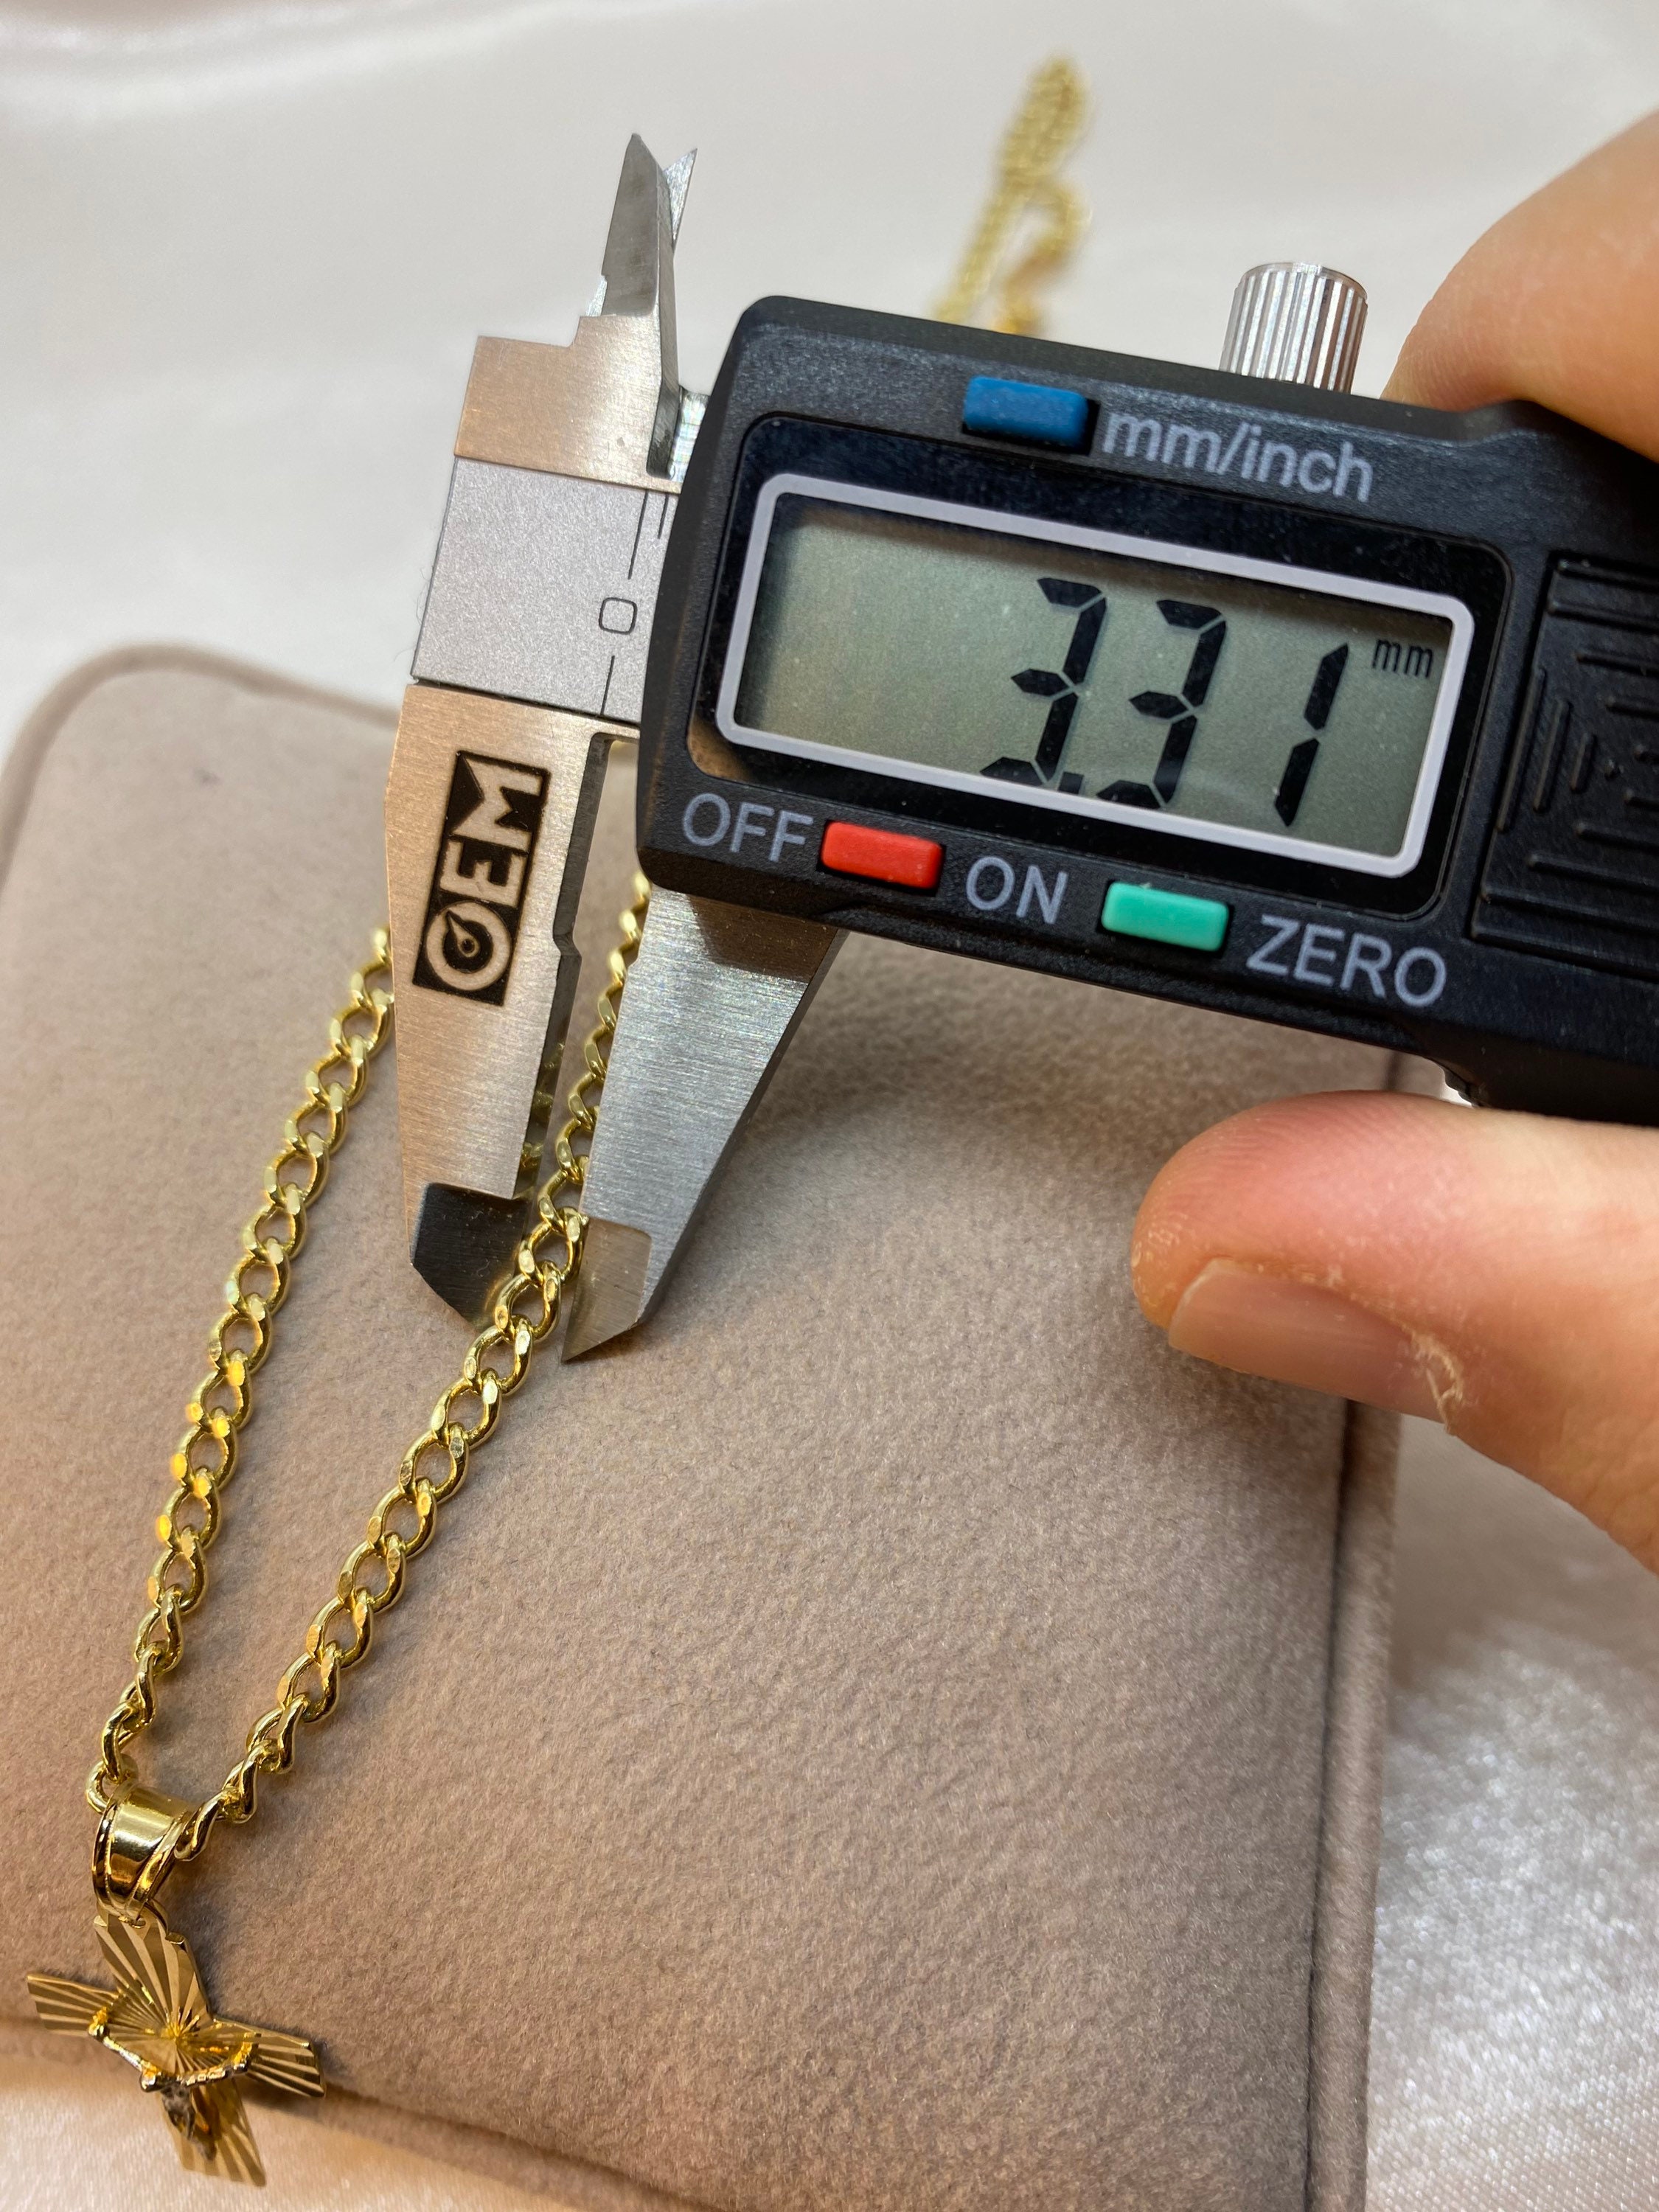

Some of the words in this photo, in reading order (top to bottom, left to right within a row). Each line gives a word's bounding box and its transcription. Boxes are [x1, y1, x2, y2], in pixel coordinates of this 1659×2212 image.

[1102, 410, 1373, 502] mm/inch
[980, 575, 1349, 827] 3.31
[1371, 635, 1434, 681] mm
[426, 754, 543, 991] OEM
[682, 791, 815, 863] OFF
[965, 853, 1069, 925] ON
[1245, 913, 1448, 1008] ZERO
